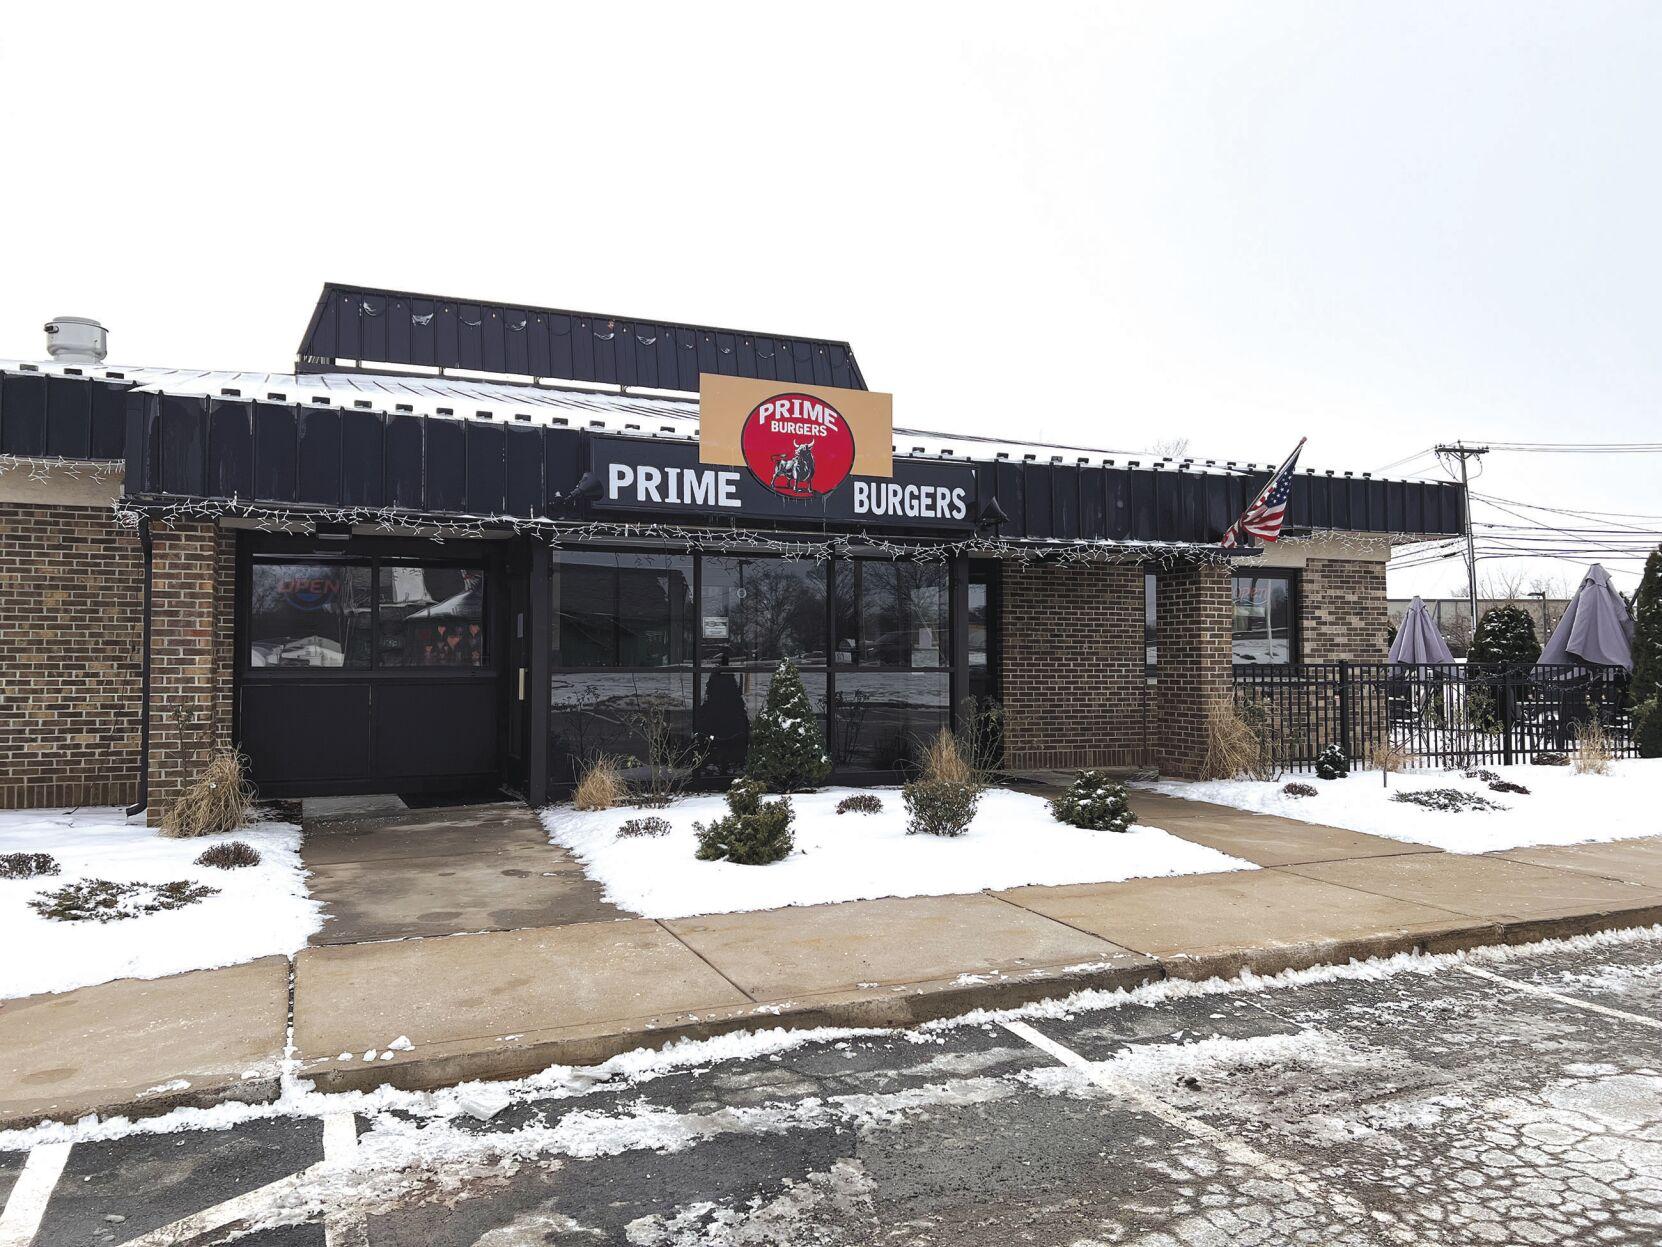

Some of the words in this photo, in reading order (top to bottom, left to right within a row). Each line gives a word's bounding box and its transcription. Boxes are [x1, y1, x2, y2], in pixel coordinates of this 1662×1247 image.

[759, 399, 839, 432] PRIME
[771, 420, 828, 437] BURGERS
[608, 463, 742, 507] PRIME
[853, 481, 967, 520] BURGERS
[277, 578, 340, 594] OPEN
